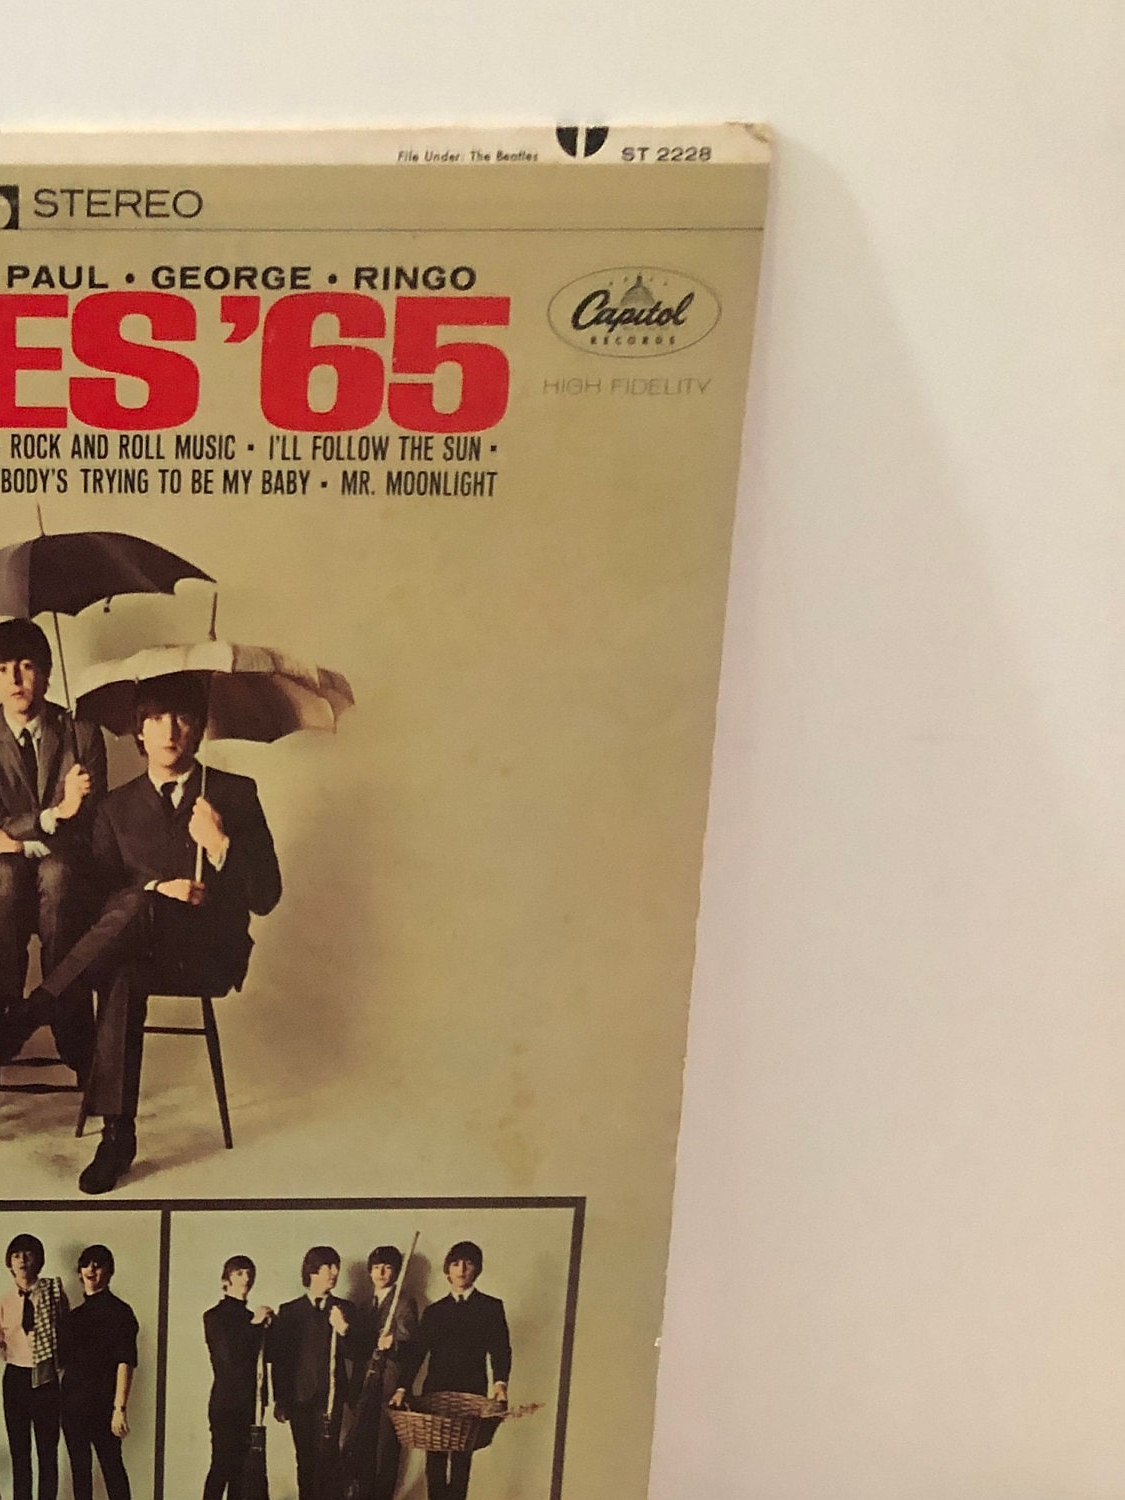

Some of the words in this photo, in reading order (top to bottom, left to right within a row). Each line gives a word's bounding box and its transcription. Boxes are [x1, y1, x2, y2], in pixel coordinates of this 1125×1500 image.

[397, 150, 420, 163] File
[470, 150, 491, 162] The
[496, 149, 539, 163] Beatles
[621, 146, 650, 162] ST
[656, 146, 712, 162] 2228
[33, 187, 204, 219] STEREO
[6, 264, 109, 290] PAUL
[151, 265, 312, 291] GEORGE
[354, 265, 477, 292] RINGO
[570, 288, 695, 333] Capitol
[589, 335, 676, 346] RECORDS
[542, 376, 603, 397] HIGH
[610, 377, 713, 397] FIDELITY
[10, 433, 62, 460] ROCK
[70, 433, 109, 460] AND
[118, 433, 166, 460] ROLL
[174, 434, 236, 461] MUSIC
[268, 434, 300, 461] I'LL
[311, 434, 391, 462] FOLLOW
[398, 434, 434, 462] THE
[442, 435, 482, 462] SUN
[79, 467, 149, 495] TRYING
[157, 468, 182, 495] TO
[191, 468, 215, 495] BE
[222, 469, 253, 495] MY
[261, 469, 311, 496] BABY
[340, 469, 376, 496] MR.
[385, 470, 499, 498] MOONLIGHT
